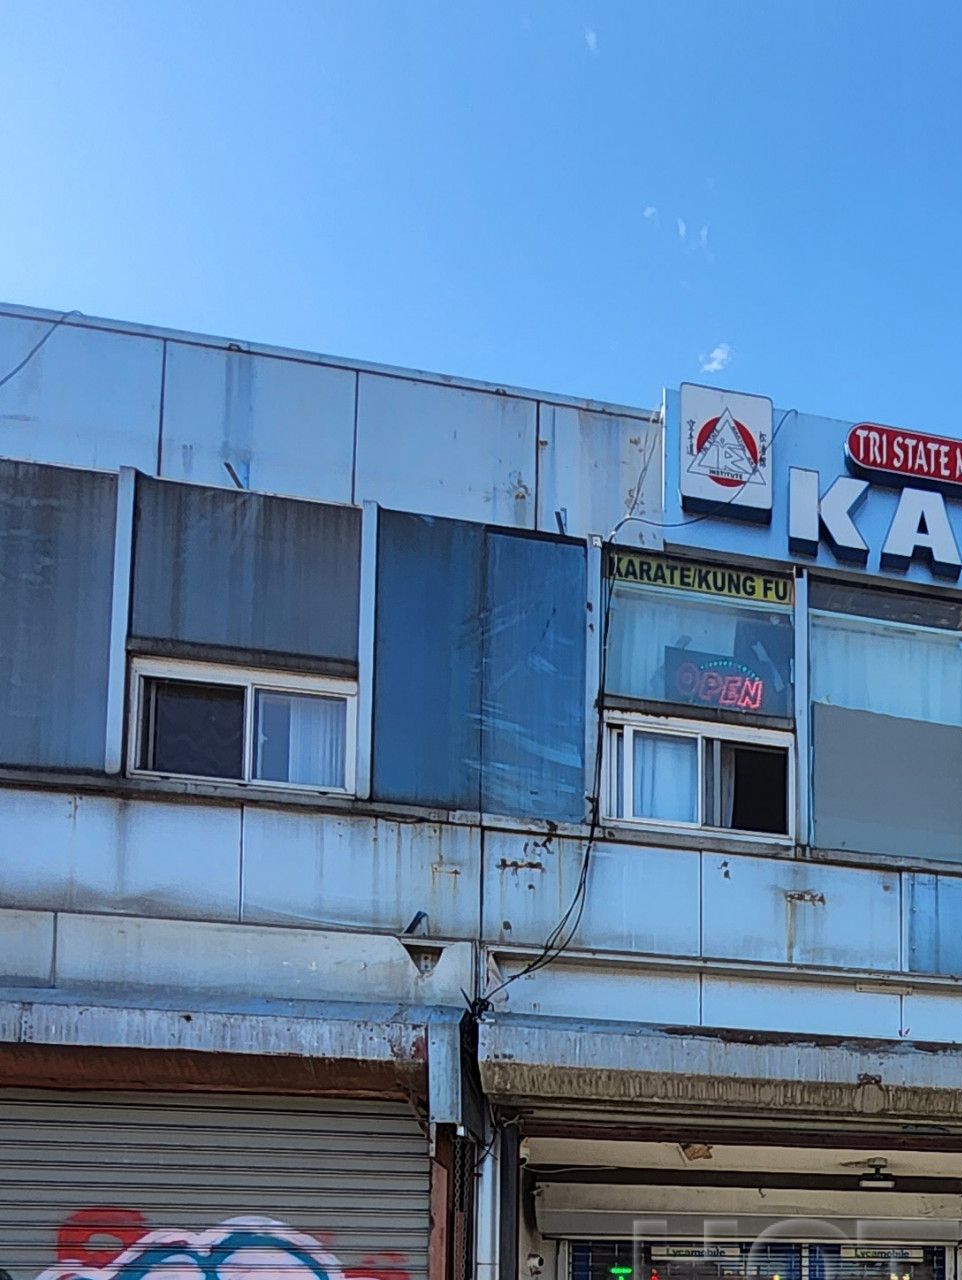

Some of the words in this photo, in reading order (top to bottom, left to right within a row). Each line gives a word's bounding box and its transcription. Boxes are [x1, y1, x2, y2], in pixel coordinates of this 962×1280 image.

[855, 428, 887, 464] TRI
[892, 436, 951, 476] STATE
[762, 577, 789, 601] FU
[676, 662, 763, 709] OPEN
